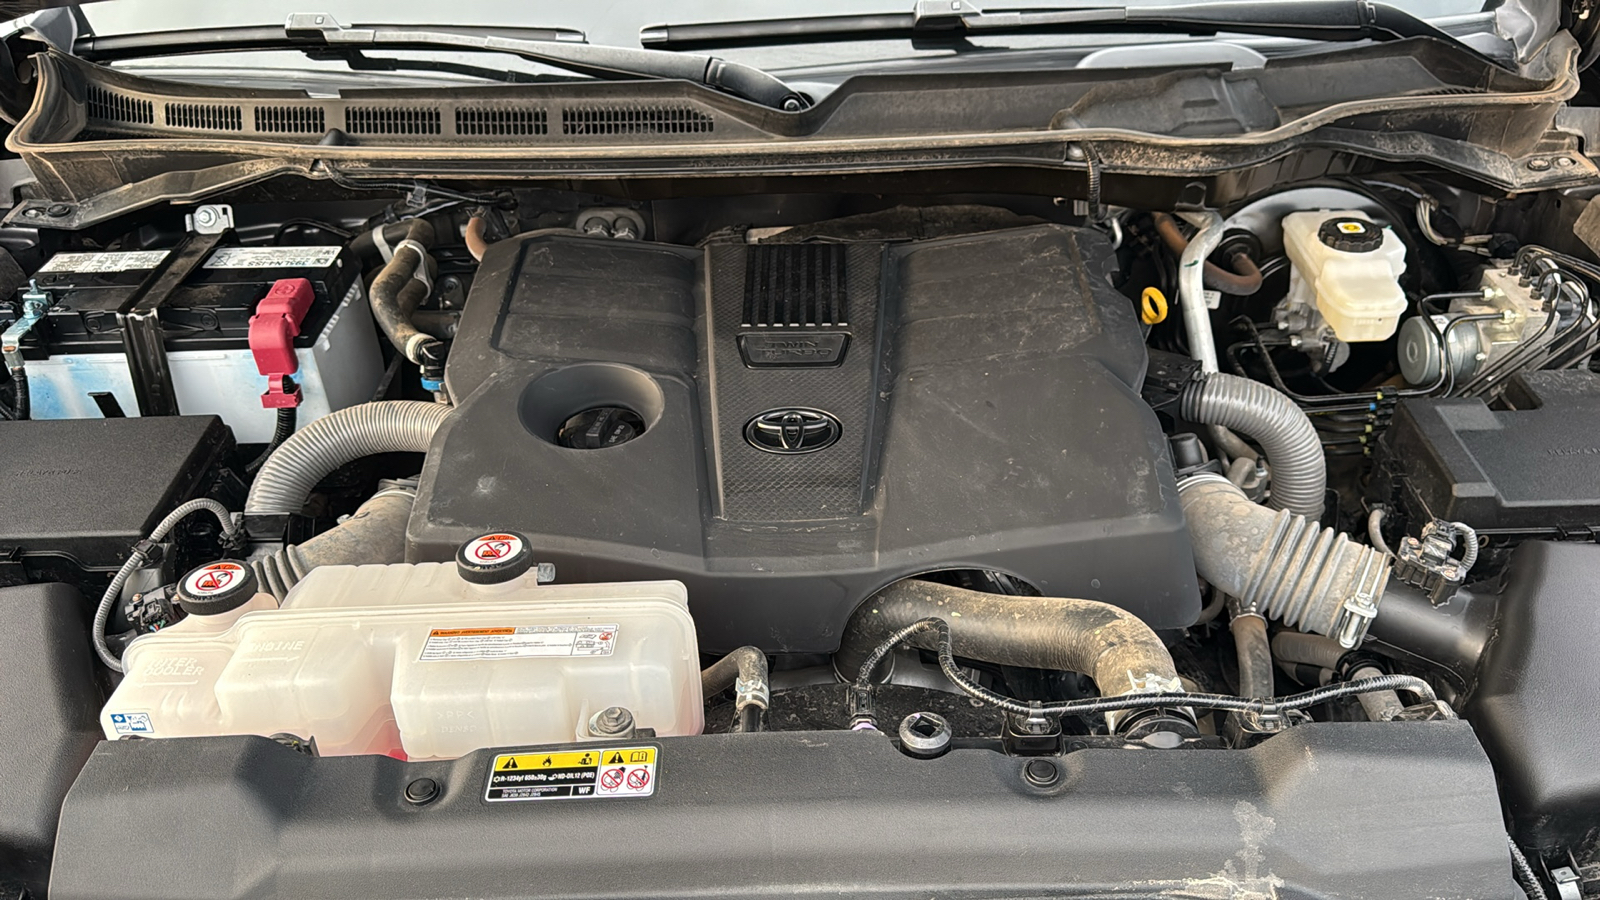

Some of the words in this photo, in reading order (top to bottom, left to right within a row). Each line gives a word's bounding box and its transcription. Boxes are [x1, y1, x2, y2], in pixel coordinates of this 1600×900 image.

[756, 348, 833, 356] TURBO
[500, 774, 523, 782] R-1234yf
[578, 787, 591, 795] WF
